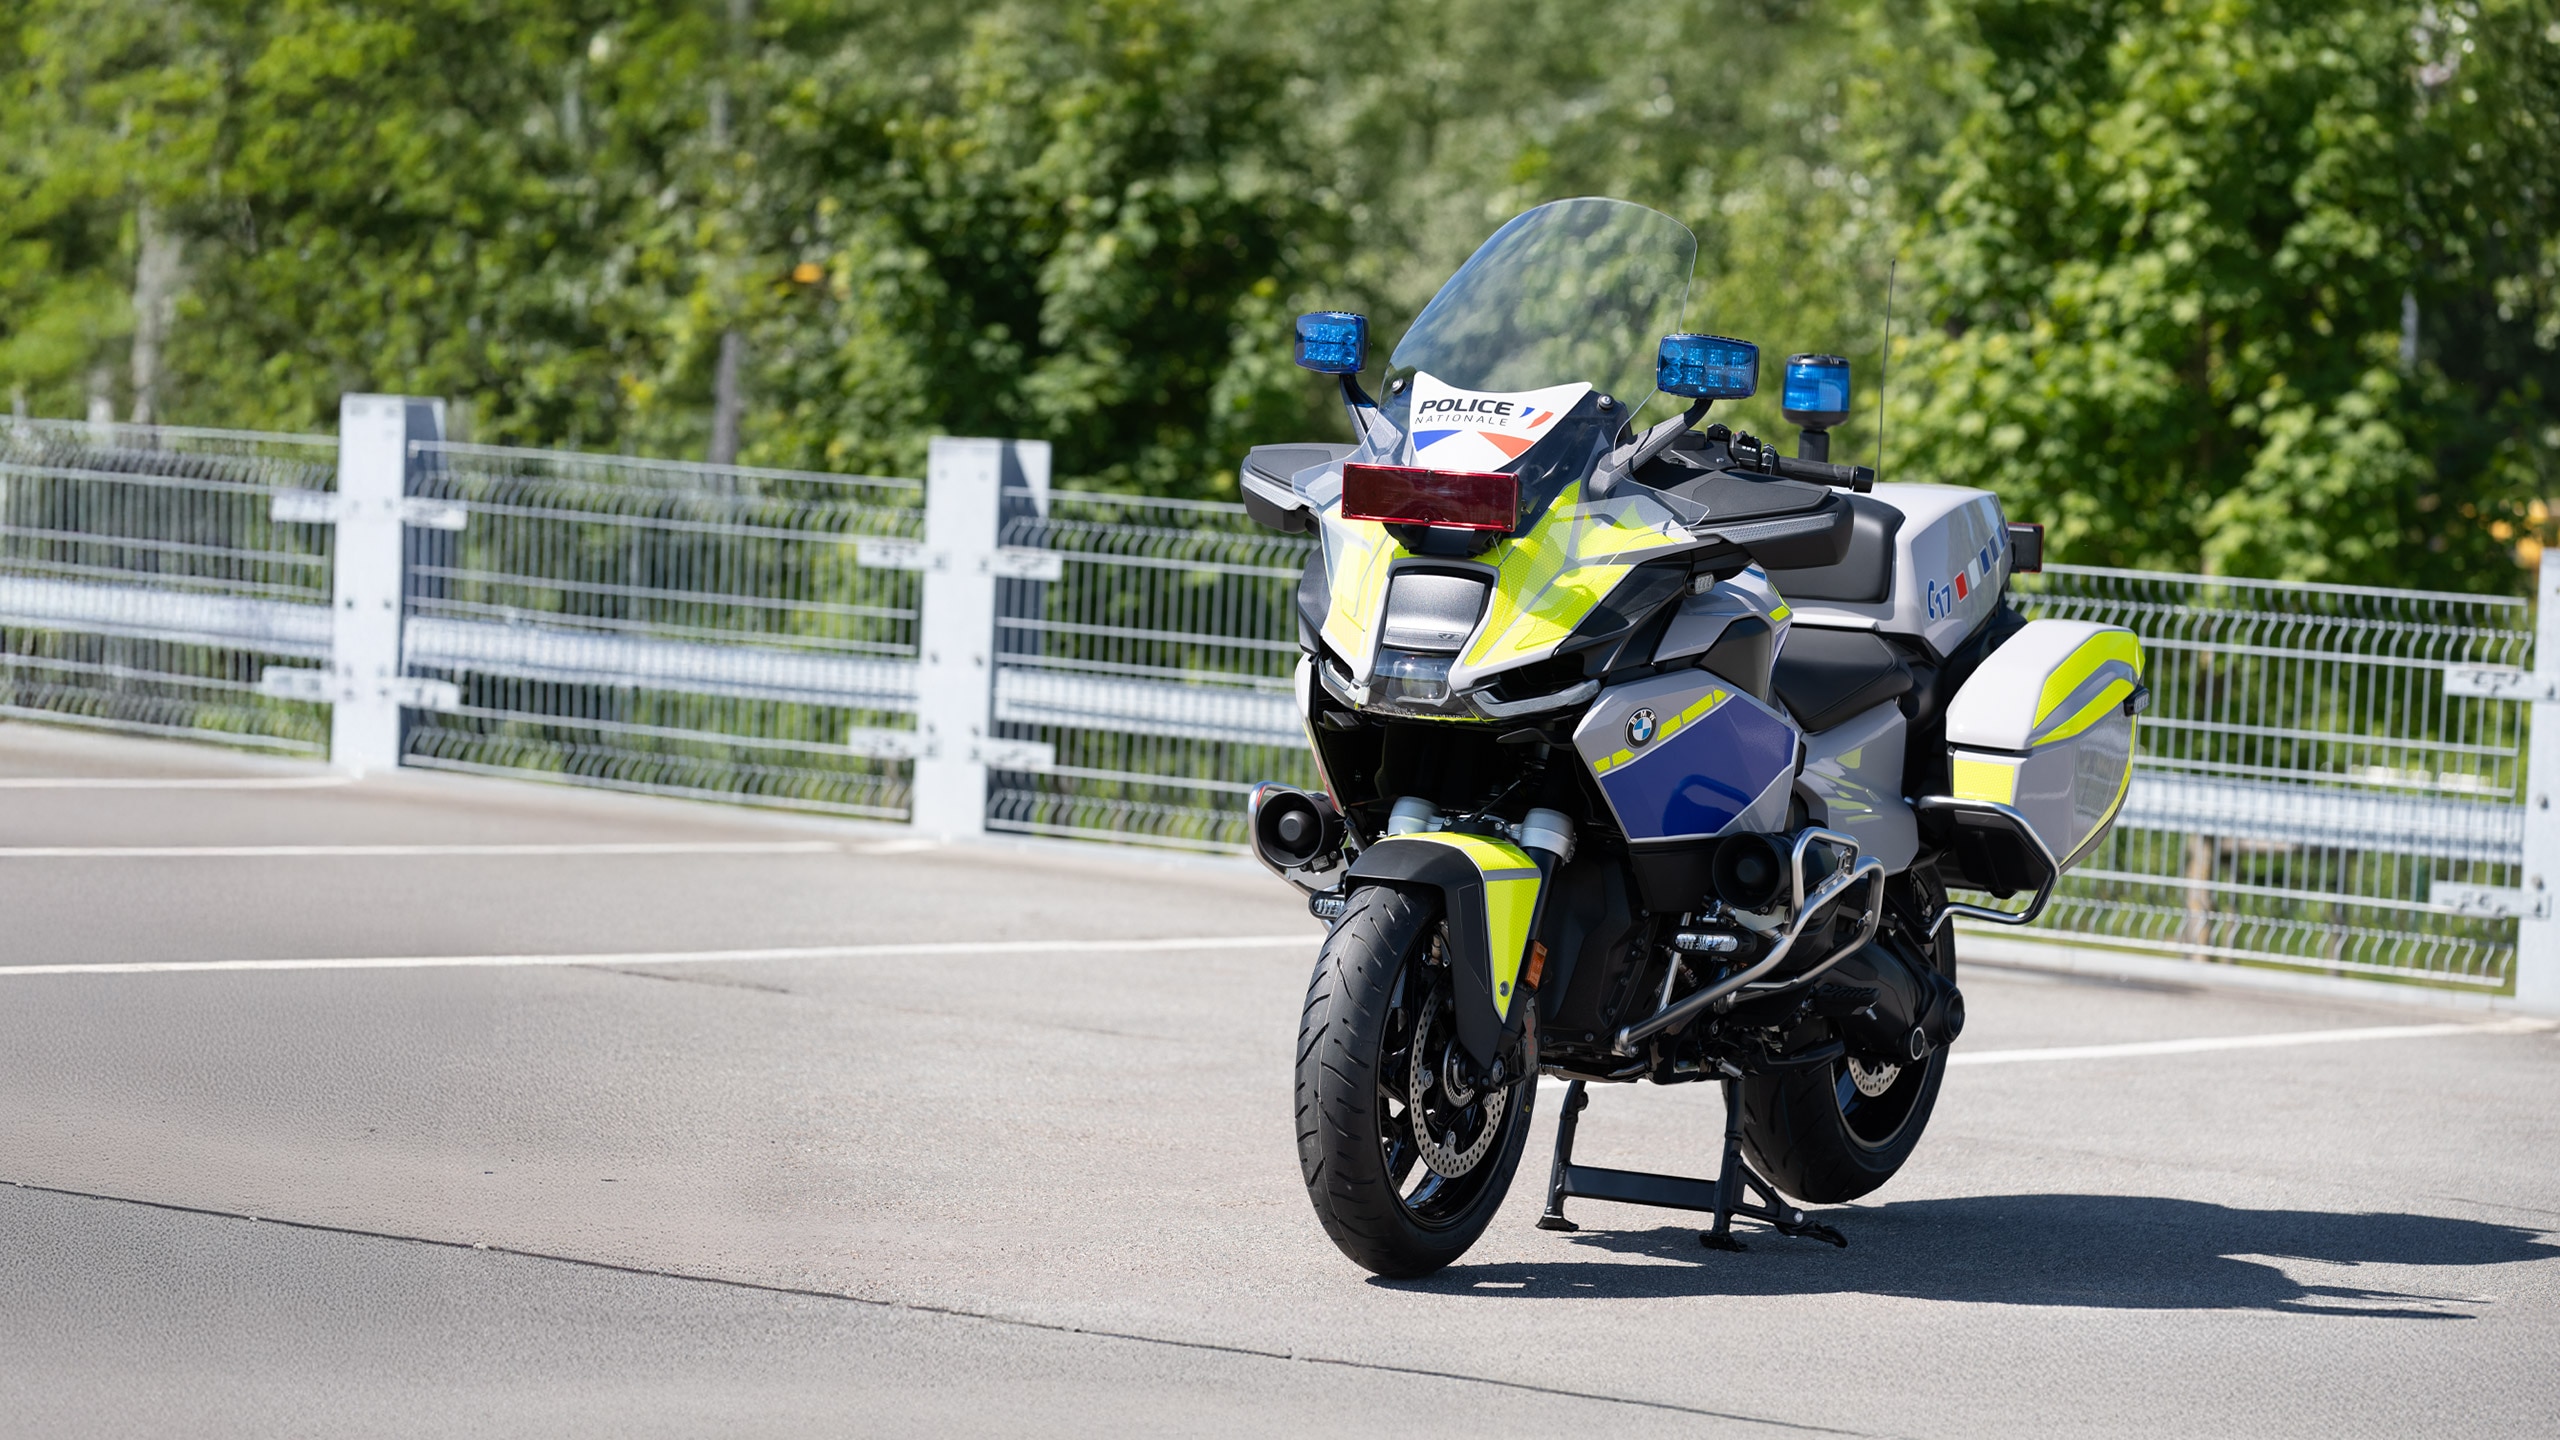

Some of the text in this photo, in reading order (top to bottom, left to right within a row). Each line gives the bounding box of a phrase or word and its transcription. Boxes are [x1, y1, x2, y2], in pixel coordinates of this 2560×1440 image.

[1418, 398, 1514, 416] POLICE
[1414, 413, 1509, 427] NATIONALE
[1934, 583, 1951, 620] 17
[1630, 709, 1656, 725] BMW
